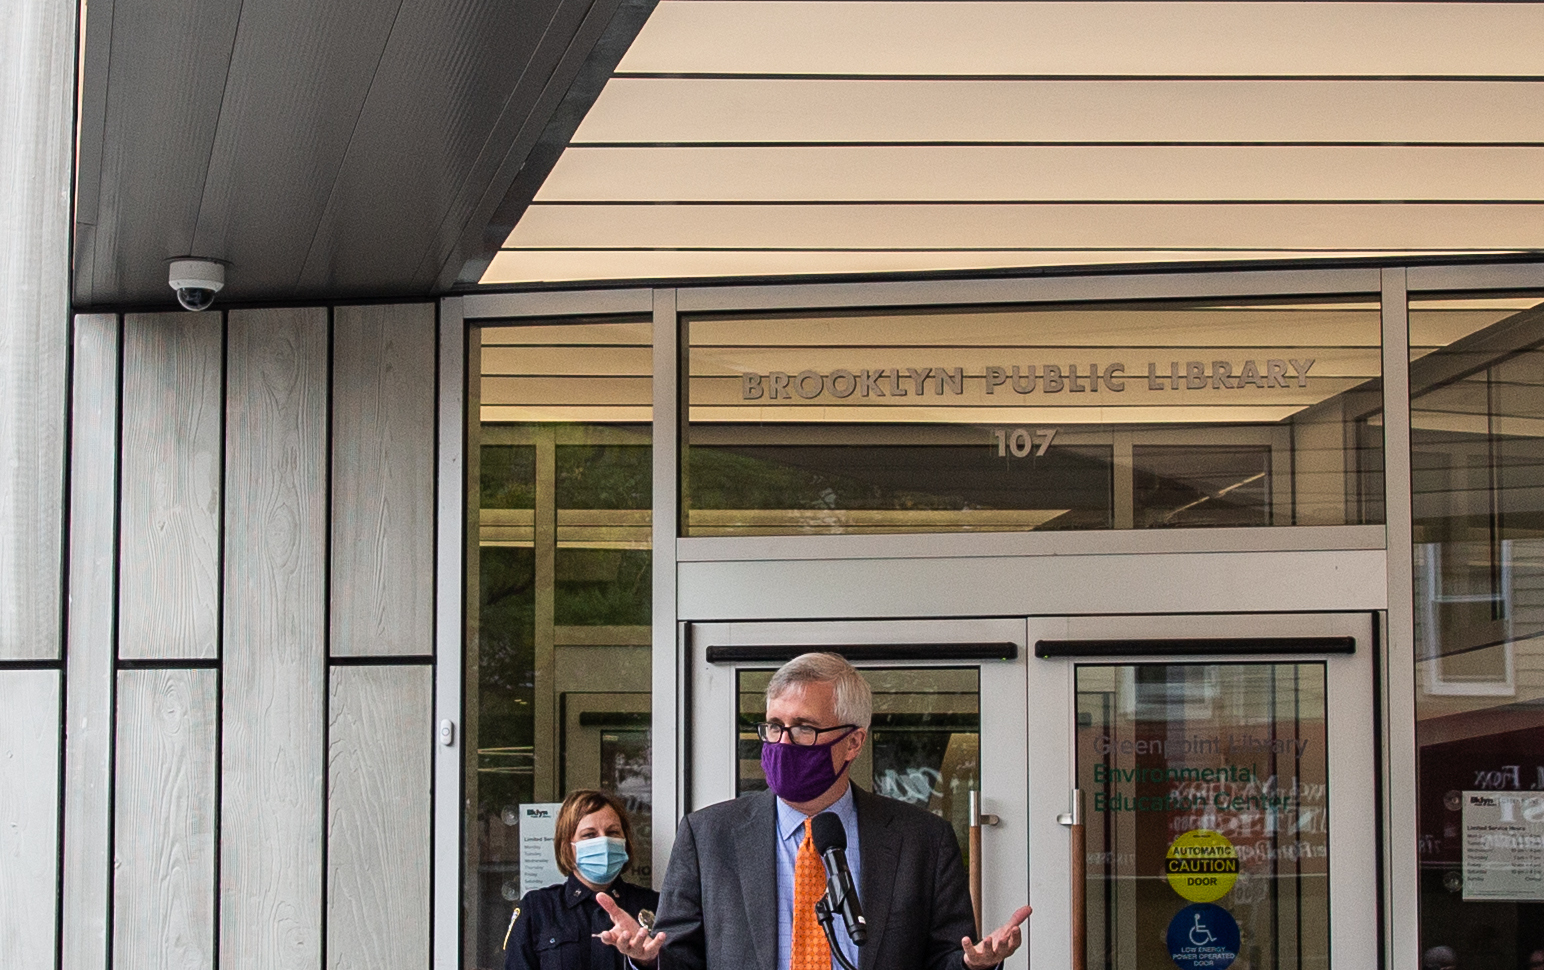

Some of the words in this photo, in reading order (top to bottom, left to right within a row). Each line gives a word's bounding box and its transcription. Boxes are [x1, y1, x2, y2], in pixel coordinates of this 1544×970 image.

[742, 367, 964, 400] BROOKLYN
[985, 362, 1125, 395] PUBLIC
[1148, 358, 1316, 391] LIBRARY
[993, 429, 1060, 458] 107
[1094, 735, 1221, 760] Greenpoint
[1229, 735, 1309, 760] Library
[1094, 763, 1257, 784] Environmental
[1094, 791, 1206, 813] Education
[1213, 791, 1290, 812] Center
[1173, 846, 1232, 856] AUTOMATIC
[1168, 859, 1236, 873] CAUTION
[1187, 877, 1217, 886] DOOR
[1199, 952, 1236, 960] OPERATED
